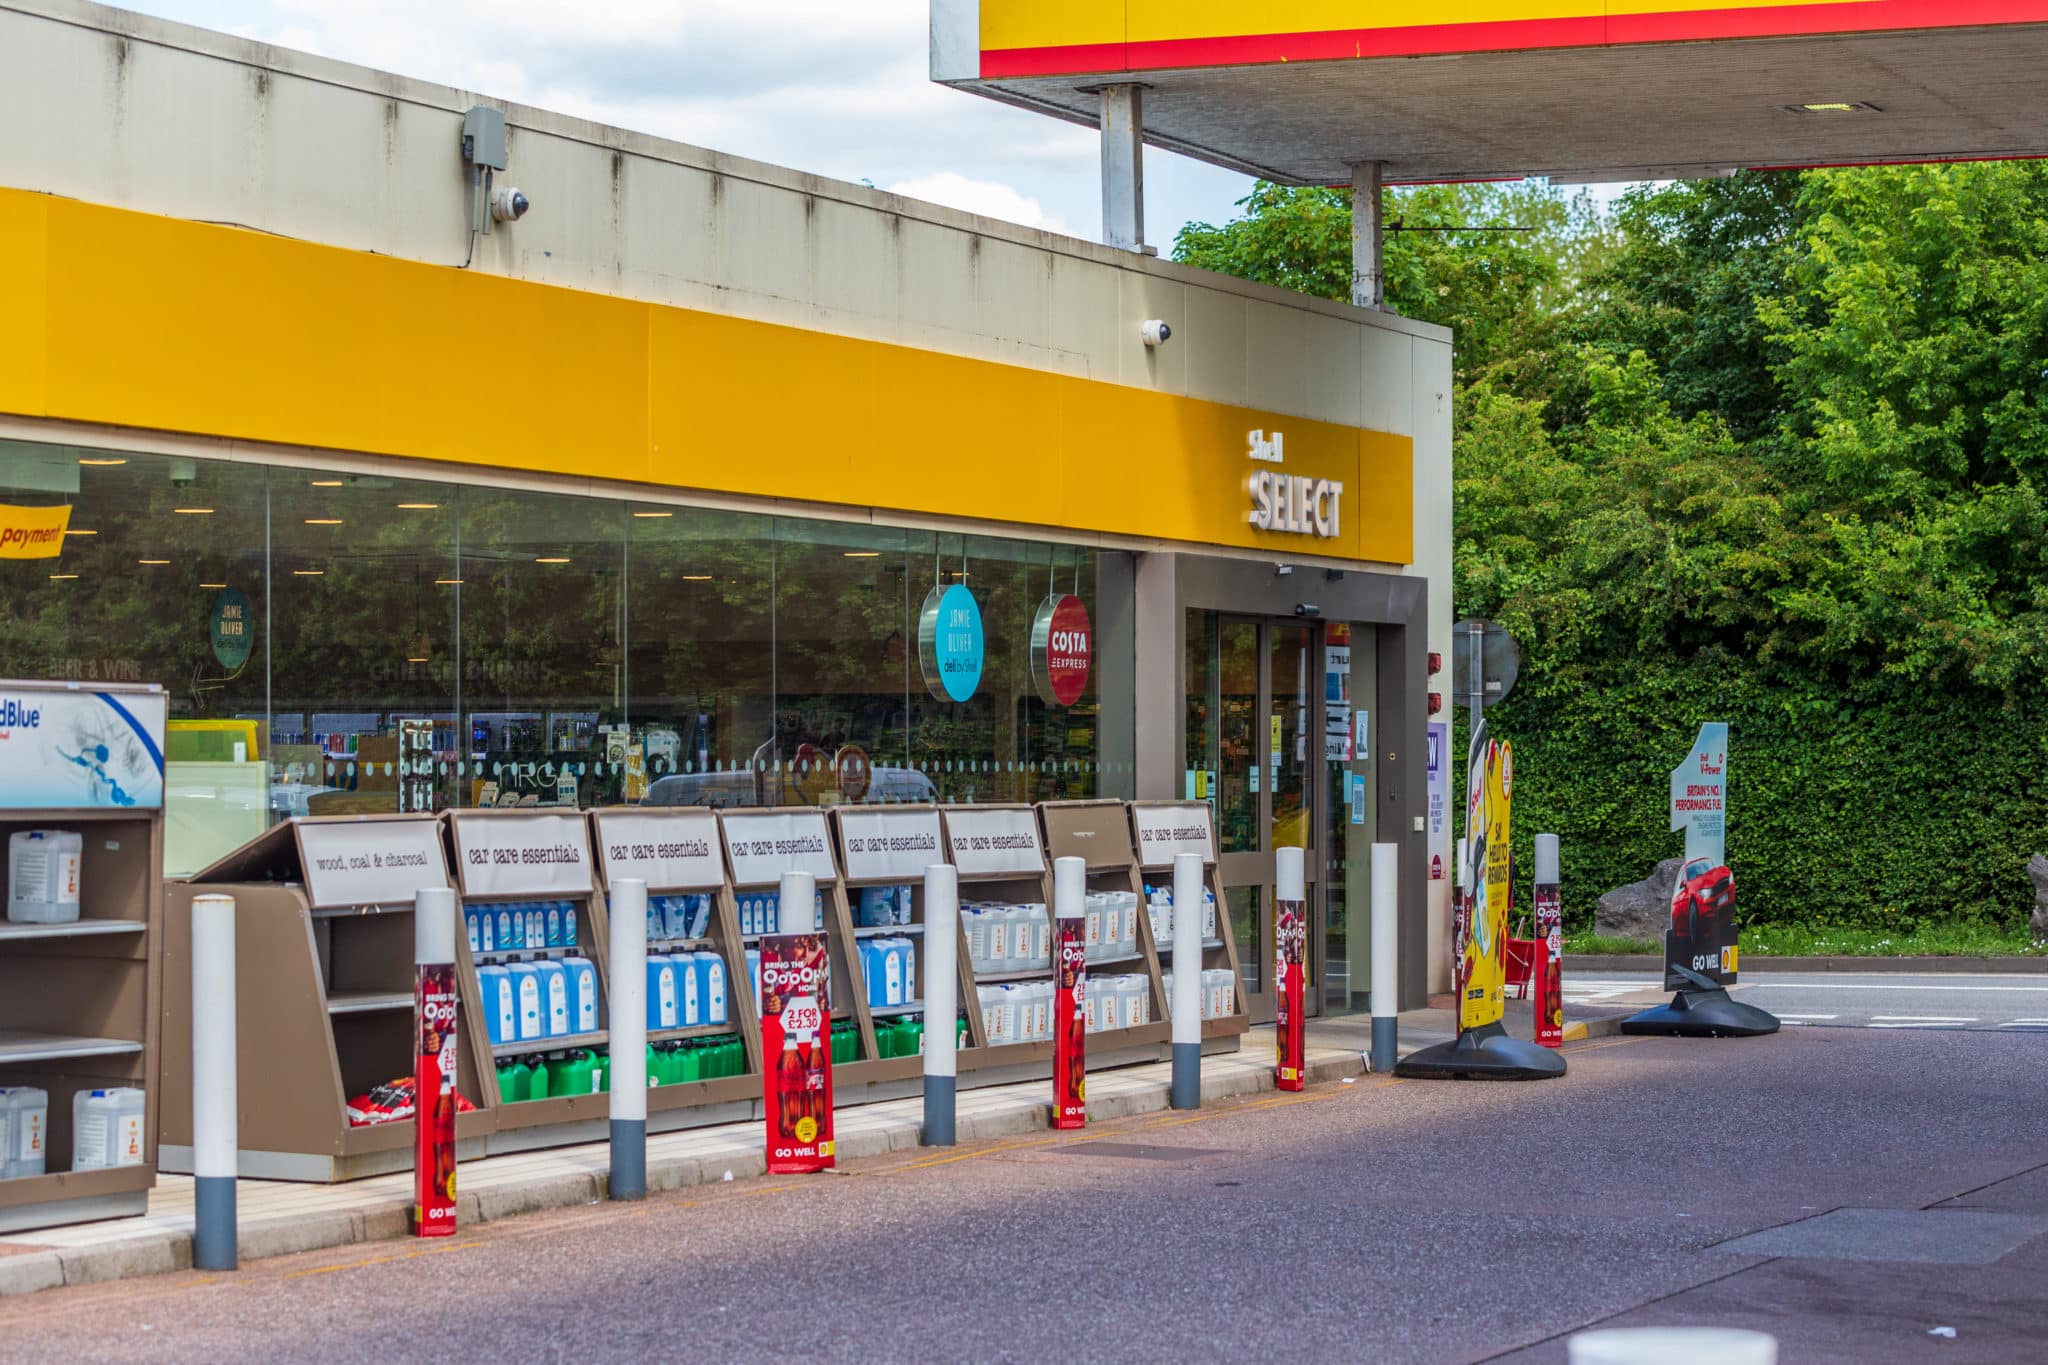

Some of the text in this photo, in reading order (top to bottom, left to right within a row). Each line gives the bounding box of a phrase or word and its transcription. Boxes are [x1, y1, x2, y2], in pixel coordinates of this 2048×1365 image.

[1253, 470, 1343, 537] SELECT
[0, 523, 60, 549] payment
[223, 605, 241, 618] JAMIE
[949, 608, 970, 628] JAMIE
[221, 621, 243, 636] OLIVER
[948, 633, 971, 653] OLIVER
[1052, 631, 1087, 654] COSTA
[103, 658, 142, 680] WINE
[944, 657, 956, 673] deli
[1056, 658, 1087, 669] EXPRESS
[0, 699, 40, 728] dBlue
[1700, 763, 1721, 775] V-Power
[1675, 799, 1712, 811] PERFORMANCE
[953, 832, 1034, 850] car care essentials
[1141, 825, 1207, 841] car care essentials
[610, 839, 709, 860] car care essentials
[732, 834, 824, 856] car care essentials
[849, 832, 935, 852] car care essentials
[350, 853, 371, 869] coal
[374, 852, 382, 867] &
[386, 850, 428, 867] charcoal
[469, 843, 580, 864] car care essentials
[764, 960, 804, 969] BRING THE
[1693, 954, 1719, 971] GO WELL
[787, 1008, 817, 1019] 2 FOR
[788, 1018, 818, 1029] £2.30
[1065, 1107, 1076, 1115] GO
[775, 1147, 815, 1158] GO WELL
[429, 1208, 444, 1218] GO
